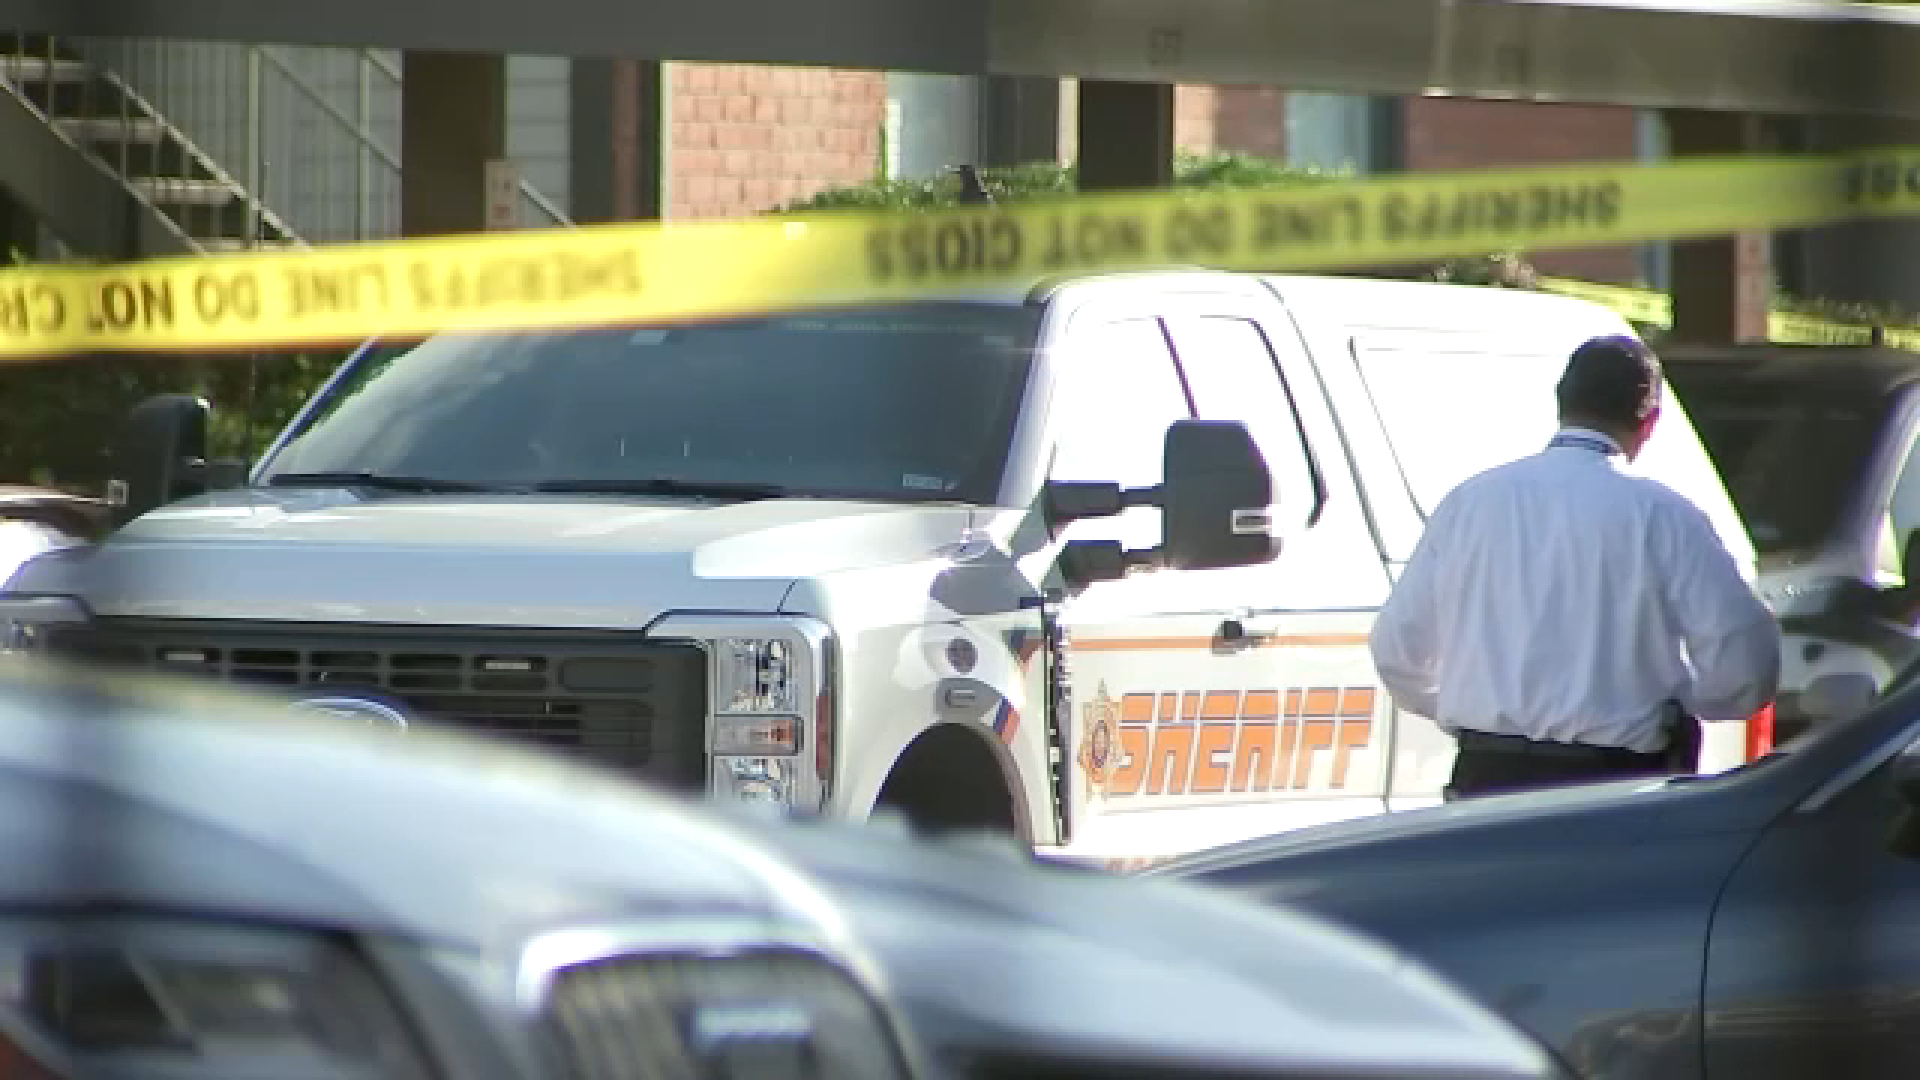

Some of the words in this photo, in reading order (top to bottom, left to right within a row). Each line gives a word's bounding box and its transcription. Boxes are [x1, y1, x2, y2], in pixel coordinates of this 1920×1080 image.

[1042, 212, 1146, 266] NOT
[1165, 204, 1233, 262] DO
[1257, 193, 1362, 252] LINE
[1381, 180, 1622, 241] SHERIFFS
[193, 272, 260, 324] DO
[287, 262, 388, 317] LINE
[408, 247, 644, 310] SHERIFFS
[1107, 686, 1377, 796] SHERIFF
